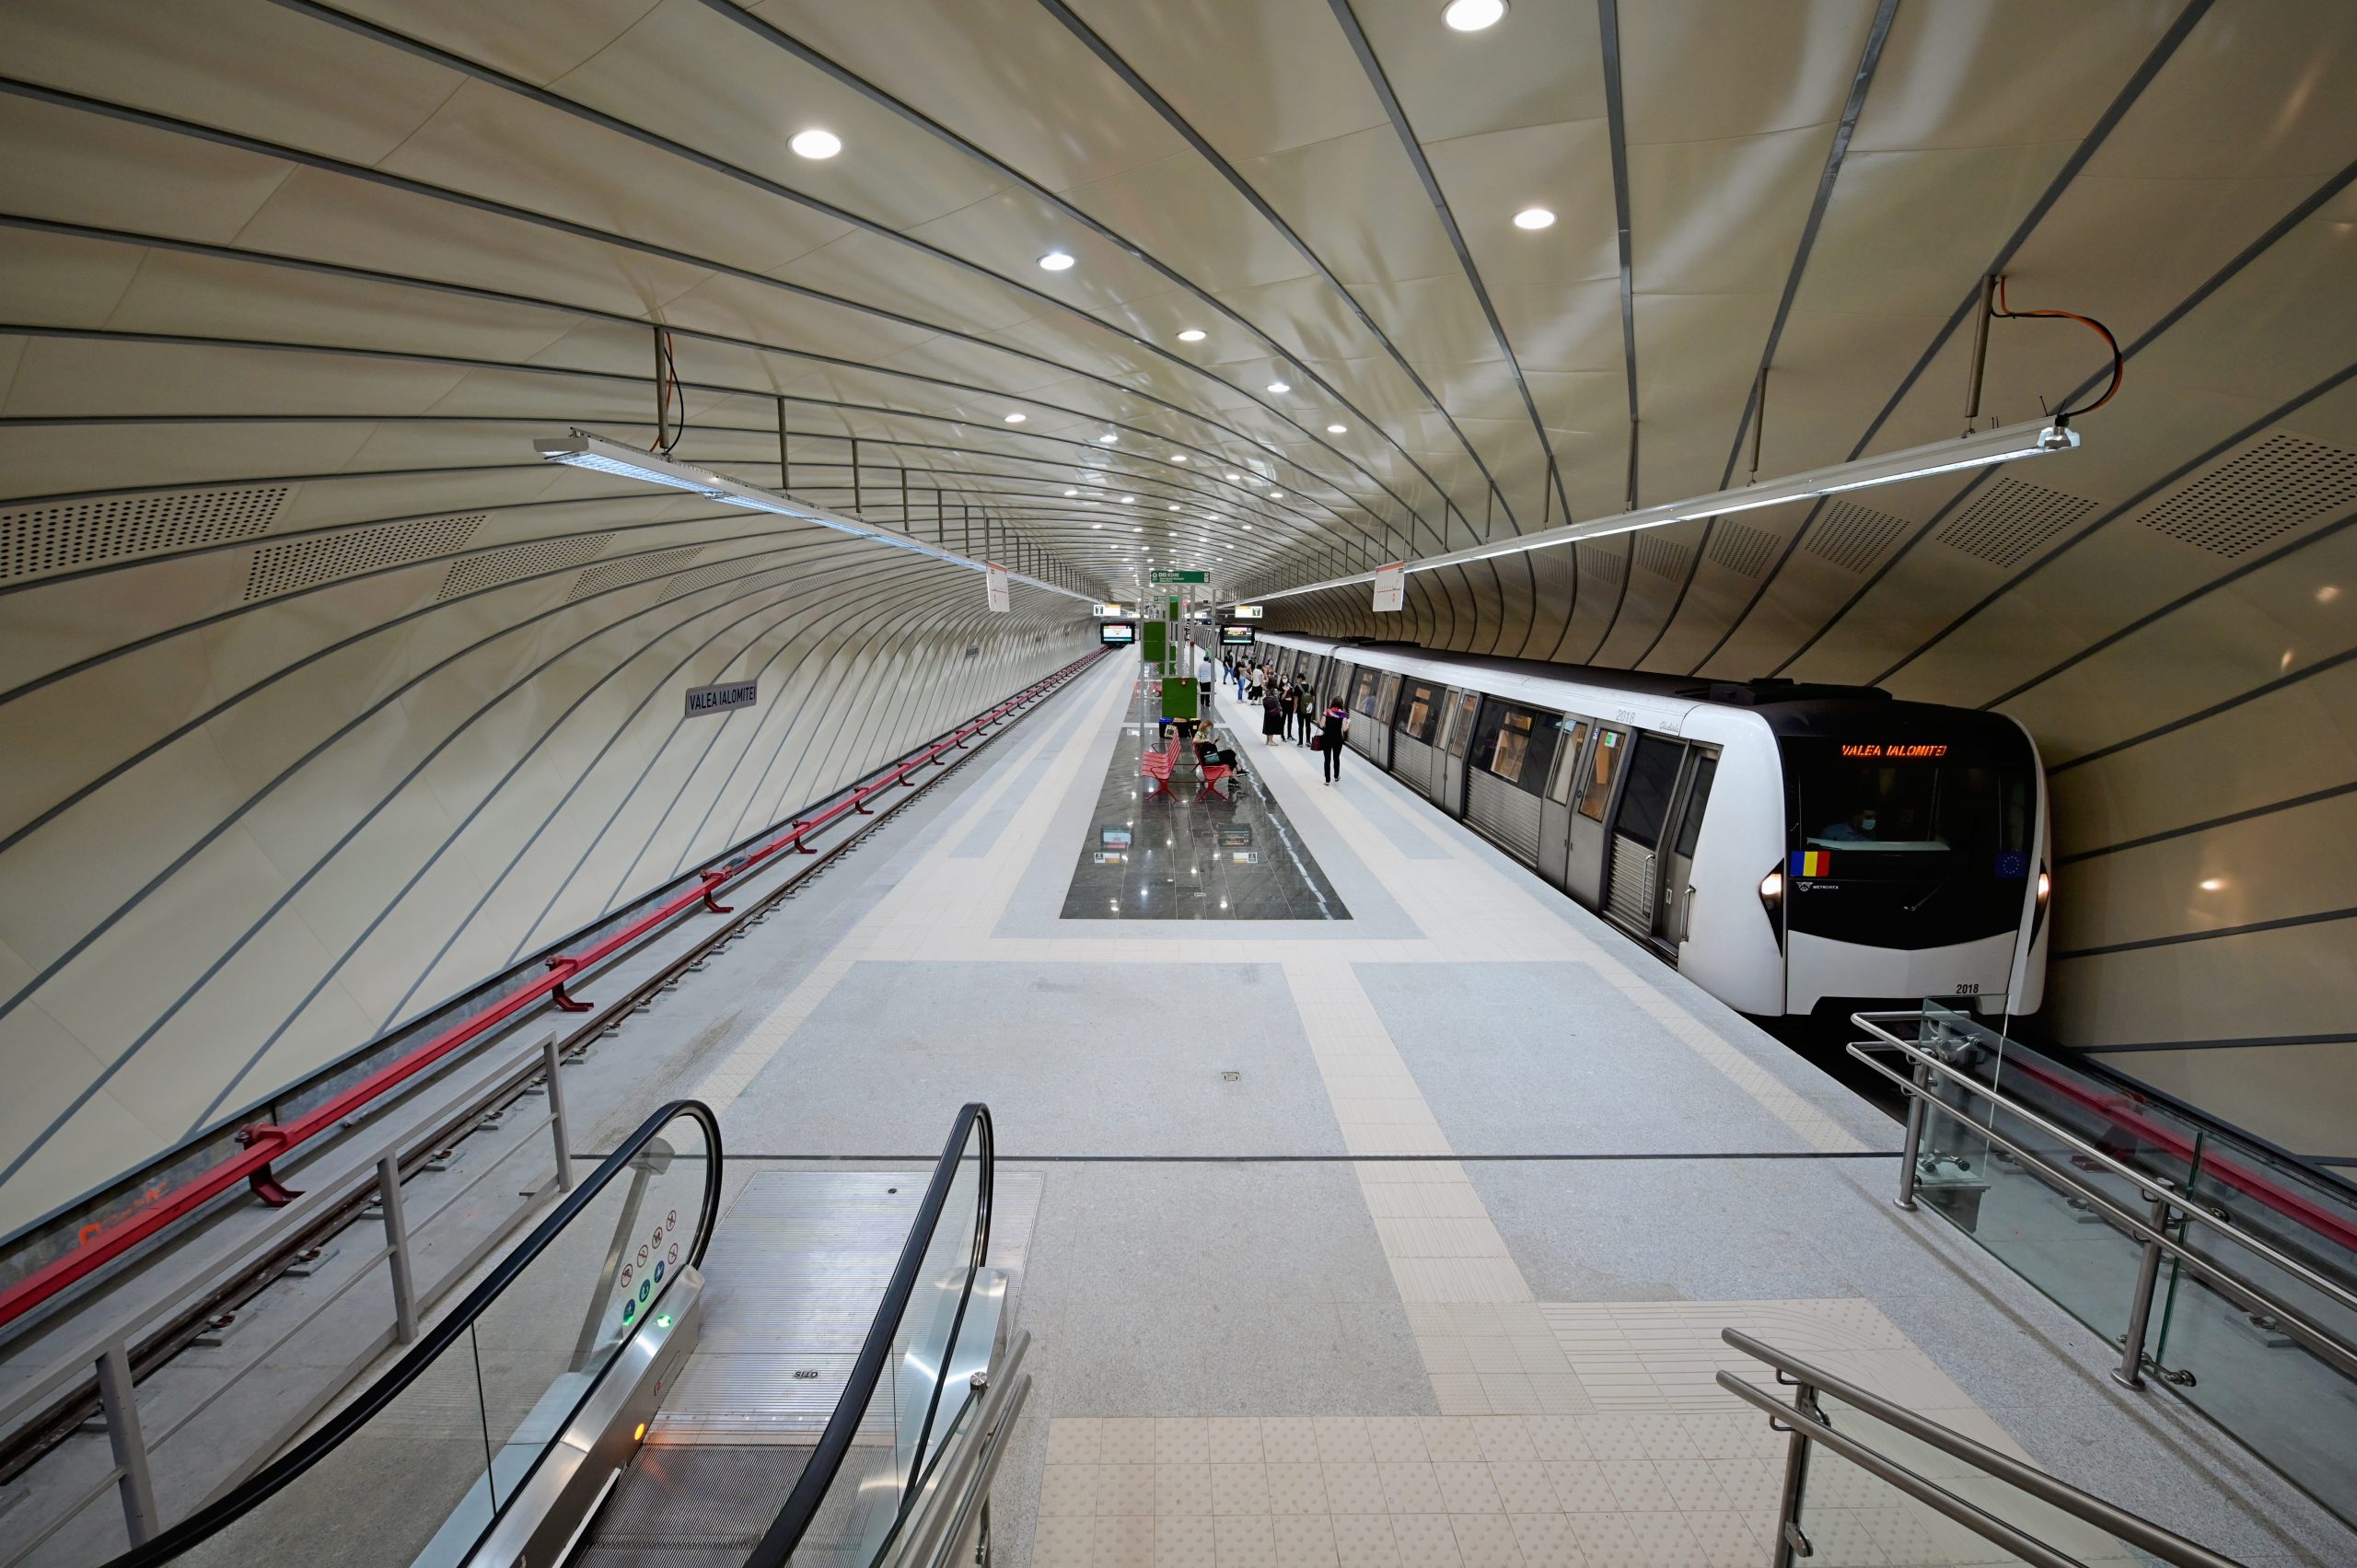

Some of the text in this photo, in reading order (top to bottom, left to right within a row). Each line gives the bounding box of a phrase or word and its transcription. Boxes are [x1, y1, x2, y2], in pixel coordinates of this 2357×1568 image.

[690, 686, 756, 711] VALEA IALOMITEI
[1615, 709, 1636, 724] 2018
[1841, 744, 1947, 757] VALEA IALOMITEI
[1956, 983, 1980, 994] 2018
